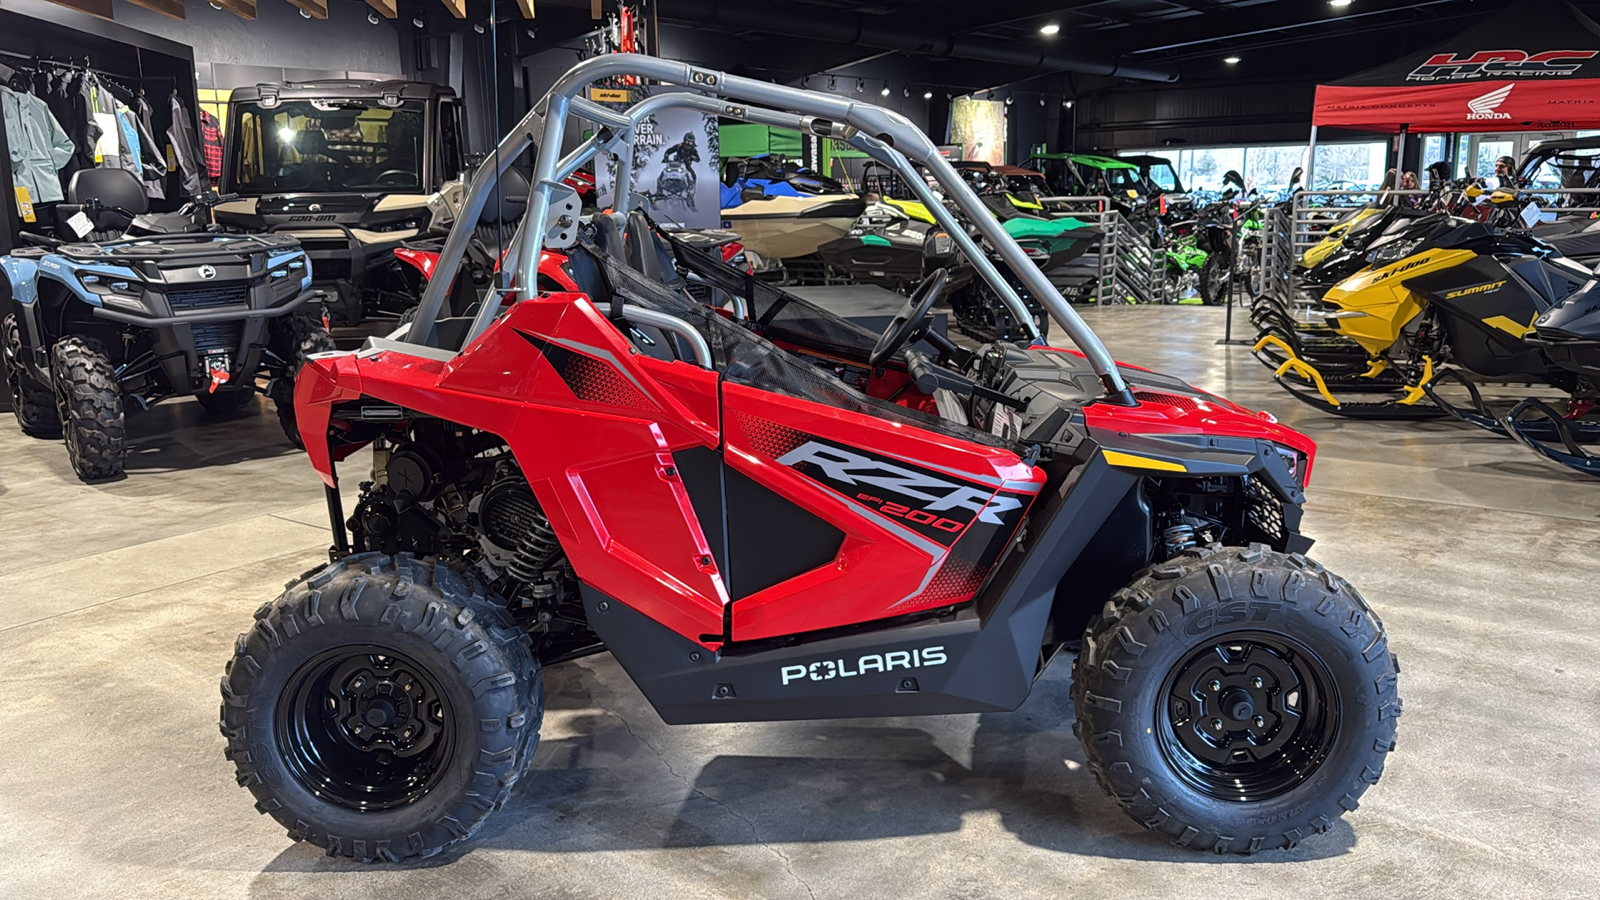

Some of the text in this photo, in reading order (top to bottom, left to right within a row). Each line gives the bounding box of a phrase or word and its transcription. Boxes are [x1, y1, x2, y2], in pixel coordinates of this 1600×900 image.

[1408, 50, 1600, 76] HRC
[633, 134, 666, 145] RRAIN.
[634, 124, 654, 134] VER
[808, 134, 818, 174] awasa
[1371, 257, 1431, 284] ski-doo
[774, 440, 1023, 526] RZR
[880, 501, 965, 533] 200
[1184, 600, 1282, 636] CST
[781, 646, 948, 685] POLARIS
